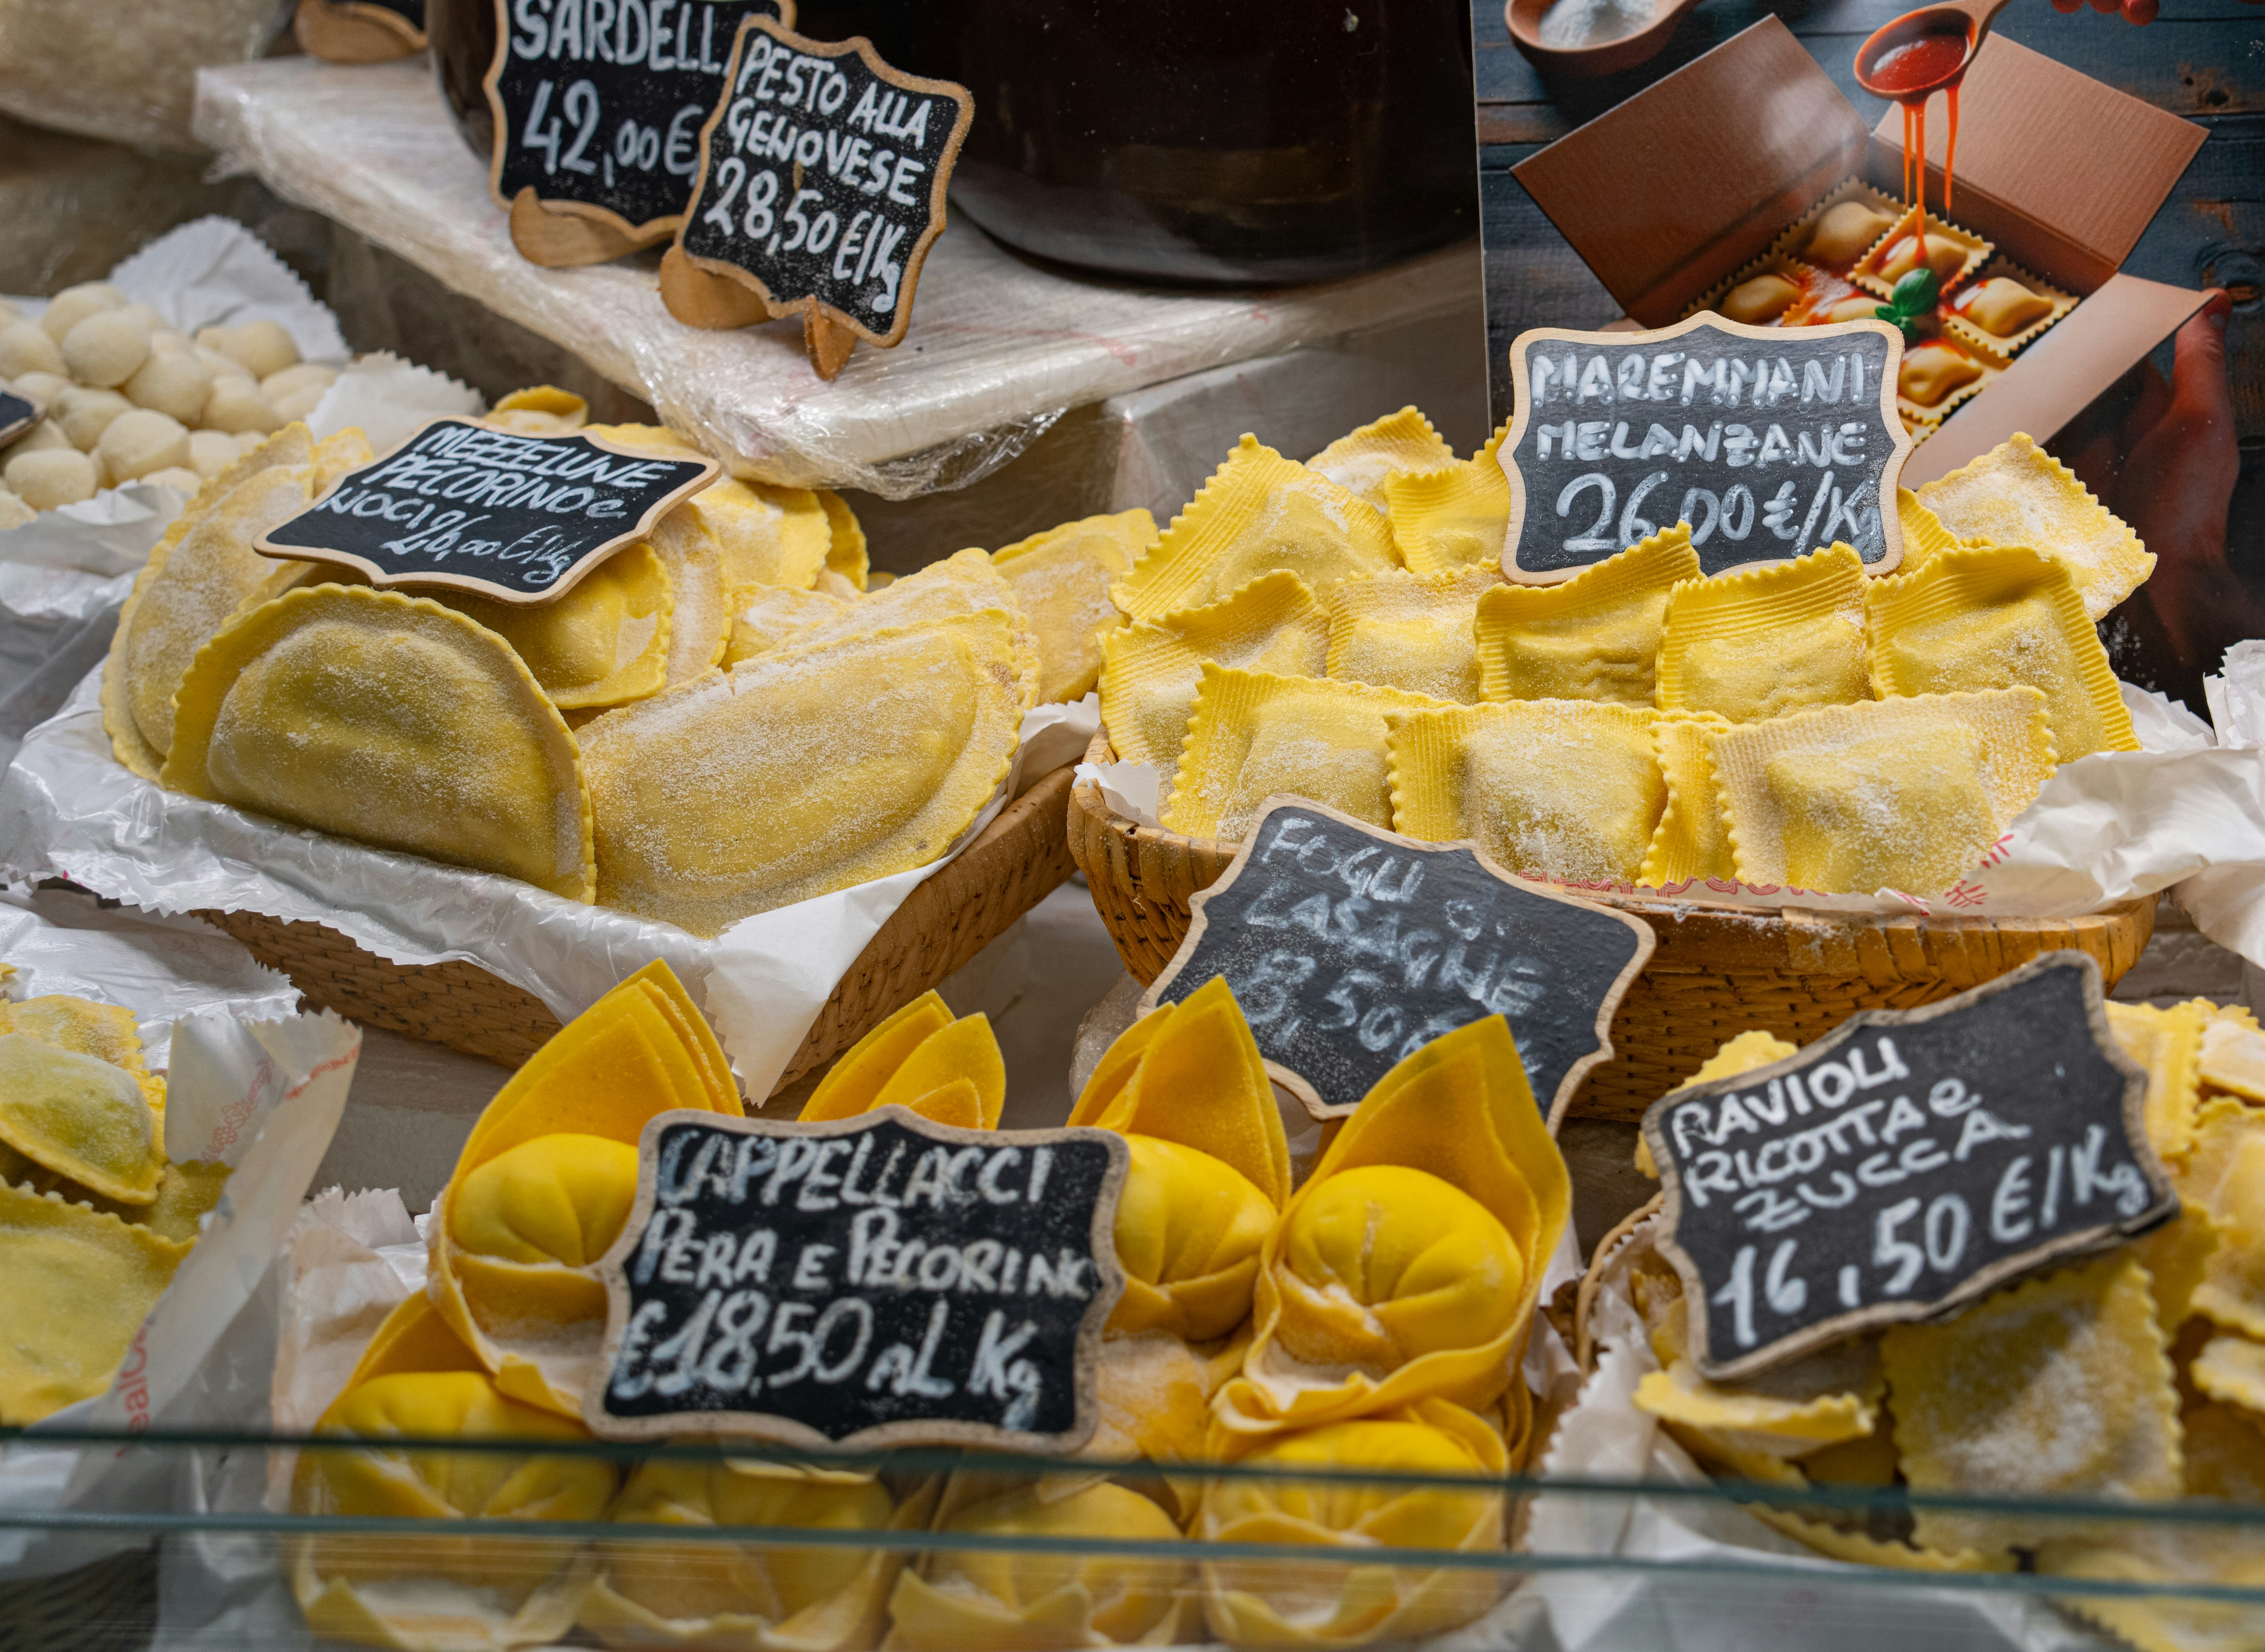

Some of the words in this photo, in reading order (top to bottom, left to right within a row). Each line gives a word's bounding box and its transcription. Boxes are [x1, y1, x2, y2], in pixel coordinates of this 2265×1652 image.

[513, 0, 733, 77] SARDELL
[736, 35, 848, 116] PESTO
[847, 82, 932, 148] ALLA
[728, 97, 926, 206] GENOVESE
[1531, 352, 1864, 410] MAREMMANI
[361, 452, 595, 513] PECORINO
[413, 426, 677, 488] MEZZELUNE
[1537, 420, 1867, 468] MELANZANE
[315, 487, 436, 529] NOCI
[1261, 816, 1424, 904] FOGLI
[1672, 1037, 1910, 1158] RAVIOLI
[658, 1128, 1055, 1210] CAPPELLACCI
[1685, 1095, 1926, 1208] RICOTTA
[1733, 1108, 2034, 1232] ZUCCA
[633, 1207, 778, 1289] PERA
